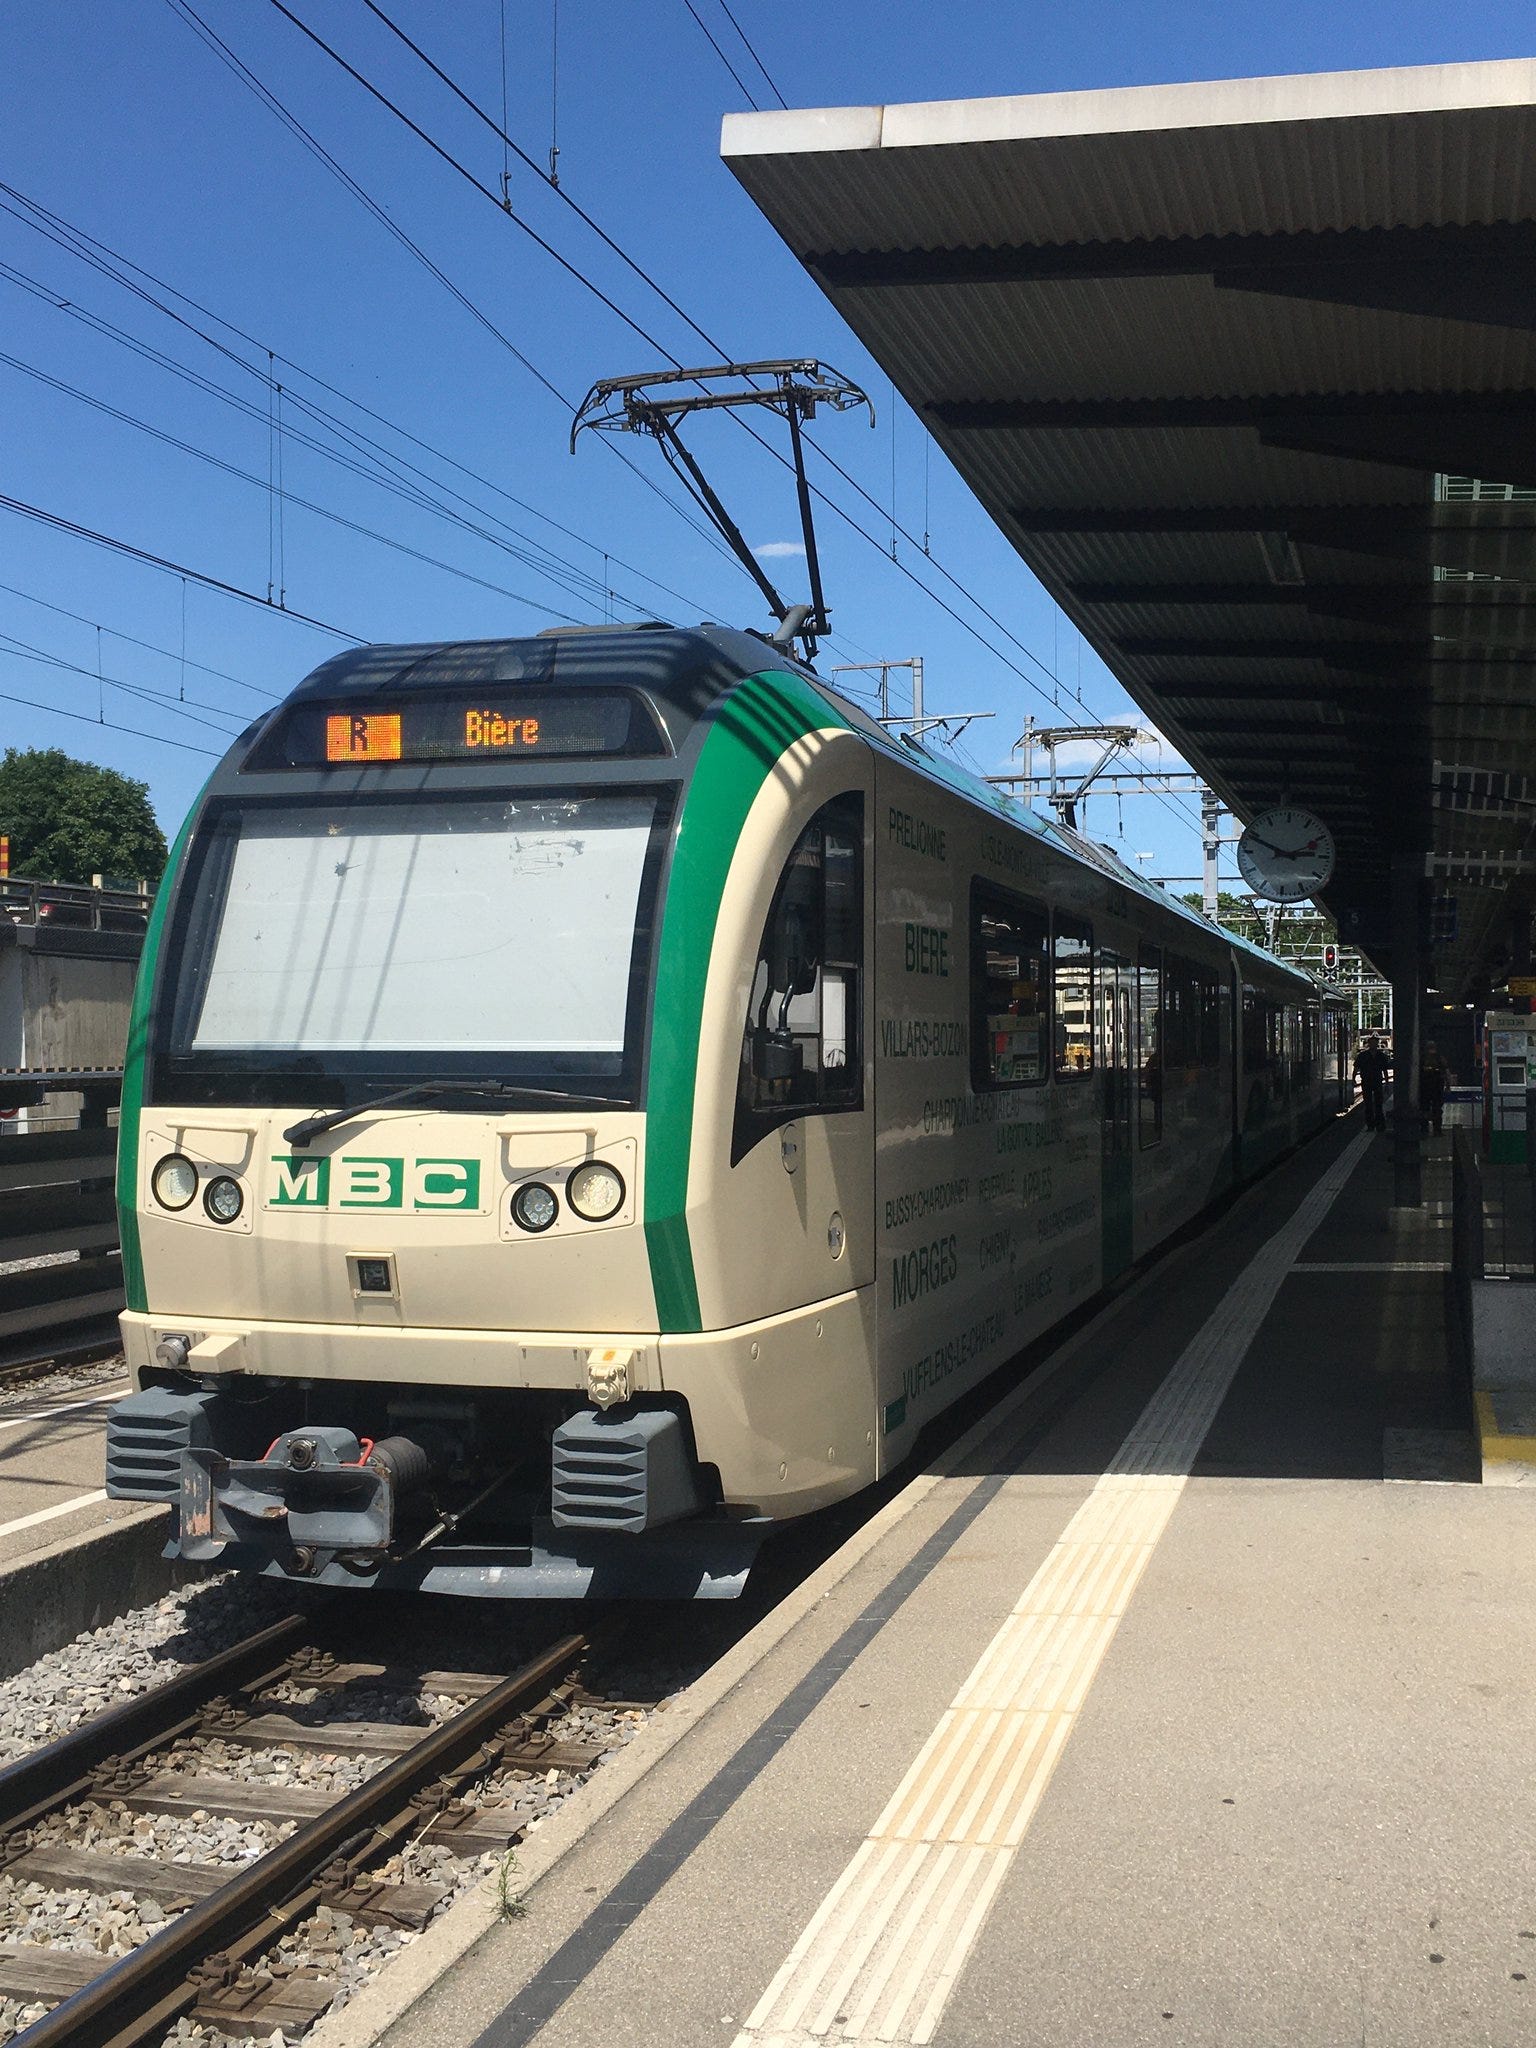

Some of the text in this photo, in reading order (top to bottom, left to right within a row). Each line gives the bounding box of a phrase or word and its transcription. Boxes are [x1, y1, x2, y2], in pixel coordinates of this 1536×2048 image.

[349, 708, 540, 752] R Bière
[888, 806, 946, 862] PRELIONNE
[1350, 912, 1361, 924] 5
[904, 922, 949, 977] BIERE
[881, 1019, 968, 1058] VILLARS-BOZON
[269, 1155, 481, 1210] MBC
[885, 1176, 970, 1230] BUSSY-CHARDONNEY
[893, 1233, 958, 1310] MORGES
